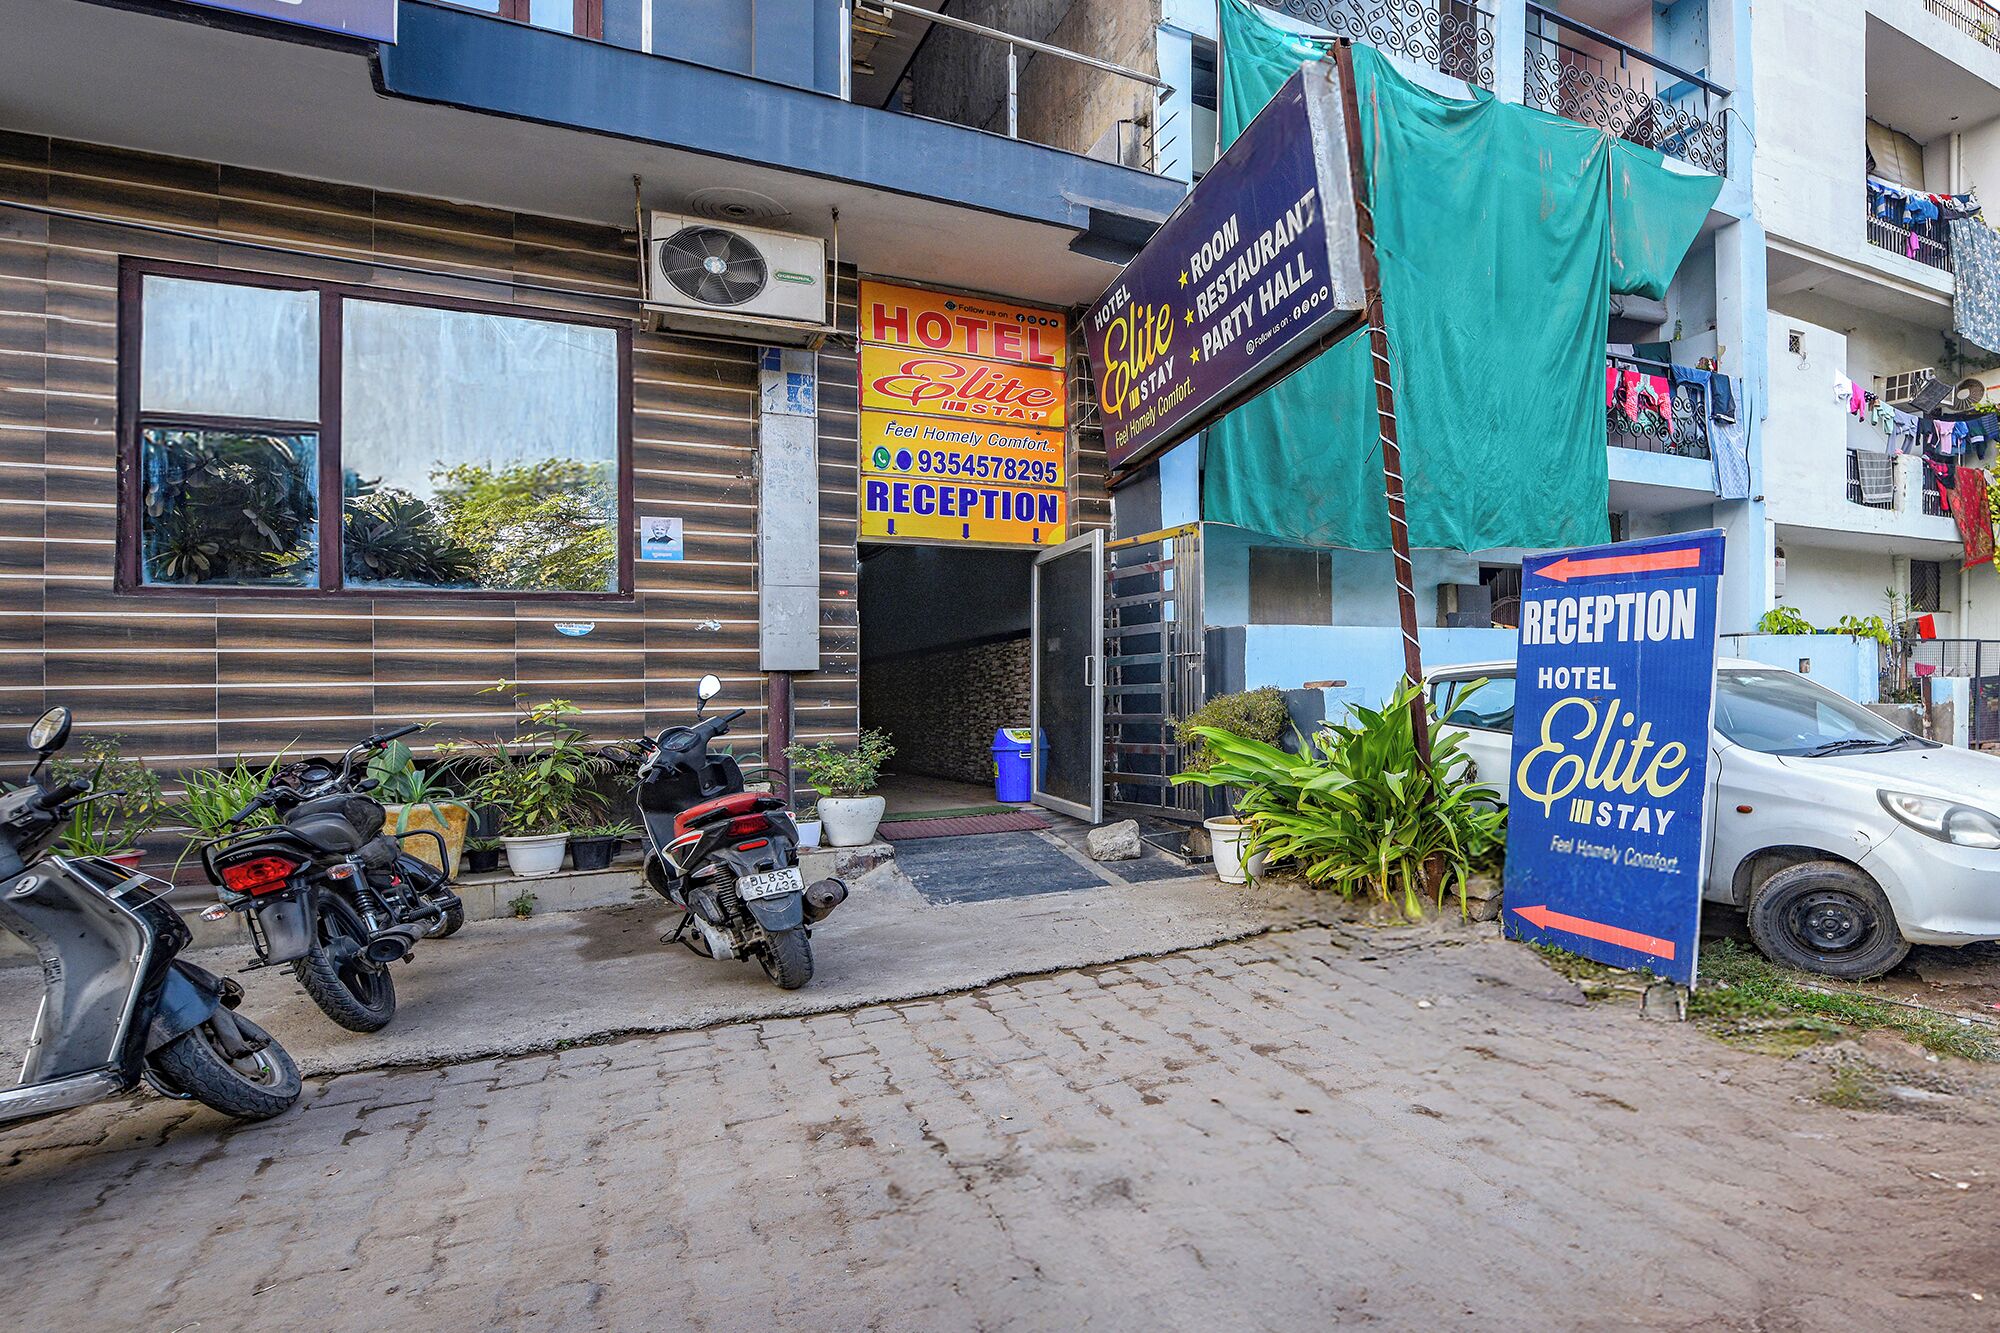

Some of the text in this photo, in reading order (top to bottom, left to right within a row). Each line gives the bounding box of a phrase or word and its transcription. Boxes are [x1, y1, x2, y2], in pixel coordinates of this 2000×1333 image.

[1189, 213, 1240, 284] ROOM
[1196, 187, 1315, 323] RESTAURANT
[958, 304, 984, 314] Follow
[1094, 284, 1131, 332] HOTEL
[1201, 251, 1313, 362] PARTY HALL
[872, 302, 1056, 365] HOTEL
[1254, 330, 1273, 348] Follow
[1272, 324, 1281, 334] us
[872, 358, 1056, 407] Elite
[1101, 301, 1175, 420] Elite
[1140, 355, 1174, 401] STAY
[884, 422, 918, 438] Feel
[923, 425, 983, 447] Homely
[1115, 424, 1129, 448] Feel
[1130, 405, 1156, 438] Homely
[917, 449, 1058, 484] 9354578295
[866, 480, 1058, 523] RECEPTION
[1522, 587, 1697, 645] RECEPTION
[1538, 666, 1617, 690] HOTEL
[1516, 696, 1691, 819] Elite
[1595, 801, 1675, 836] STAY
[1550, 835, 1574, 854] Feel
[1576, 839, 1622, 865] Homely
